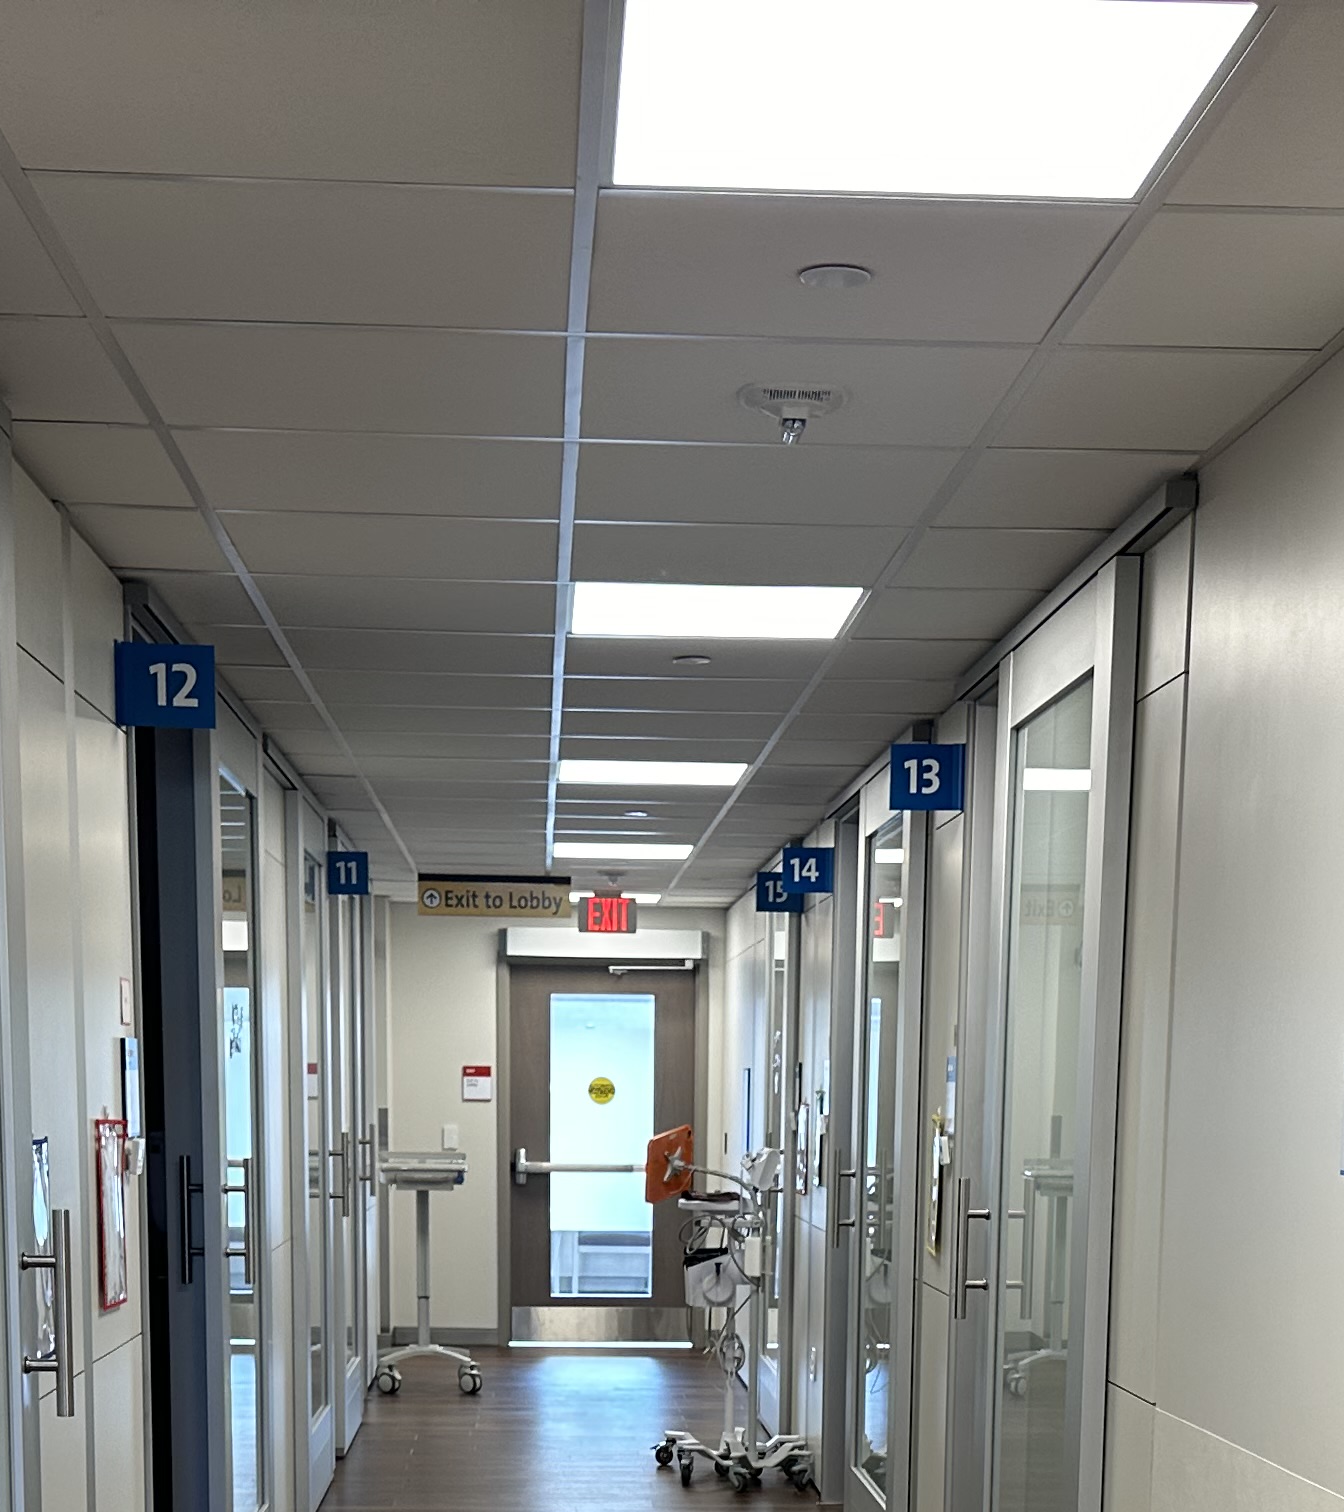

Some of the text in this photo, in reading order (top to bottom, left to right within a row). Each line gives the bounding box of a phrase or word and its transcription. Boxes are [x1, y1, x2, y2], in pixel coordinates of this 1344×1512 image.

[148, 662, 199, 708] 12
[904, 758, 941, 795] 13
[335, 860, 358, 886] 11
[790, 857, 820, 883] 14
[444, 890, 563, 916] Exit to Lobby
[765, 880, 789, 903] 15
[587, 897, 630, 931] EXIT
